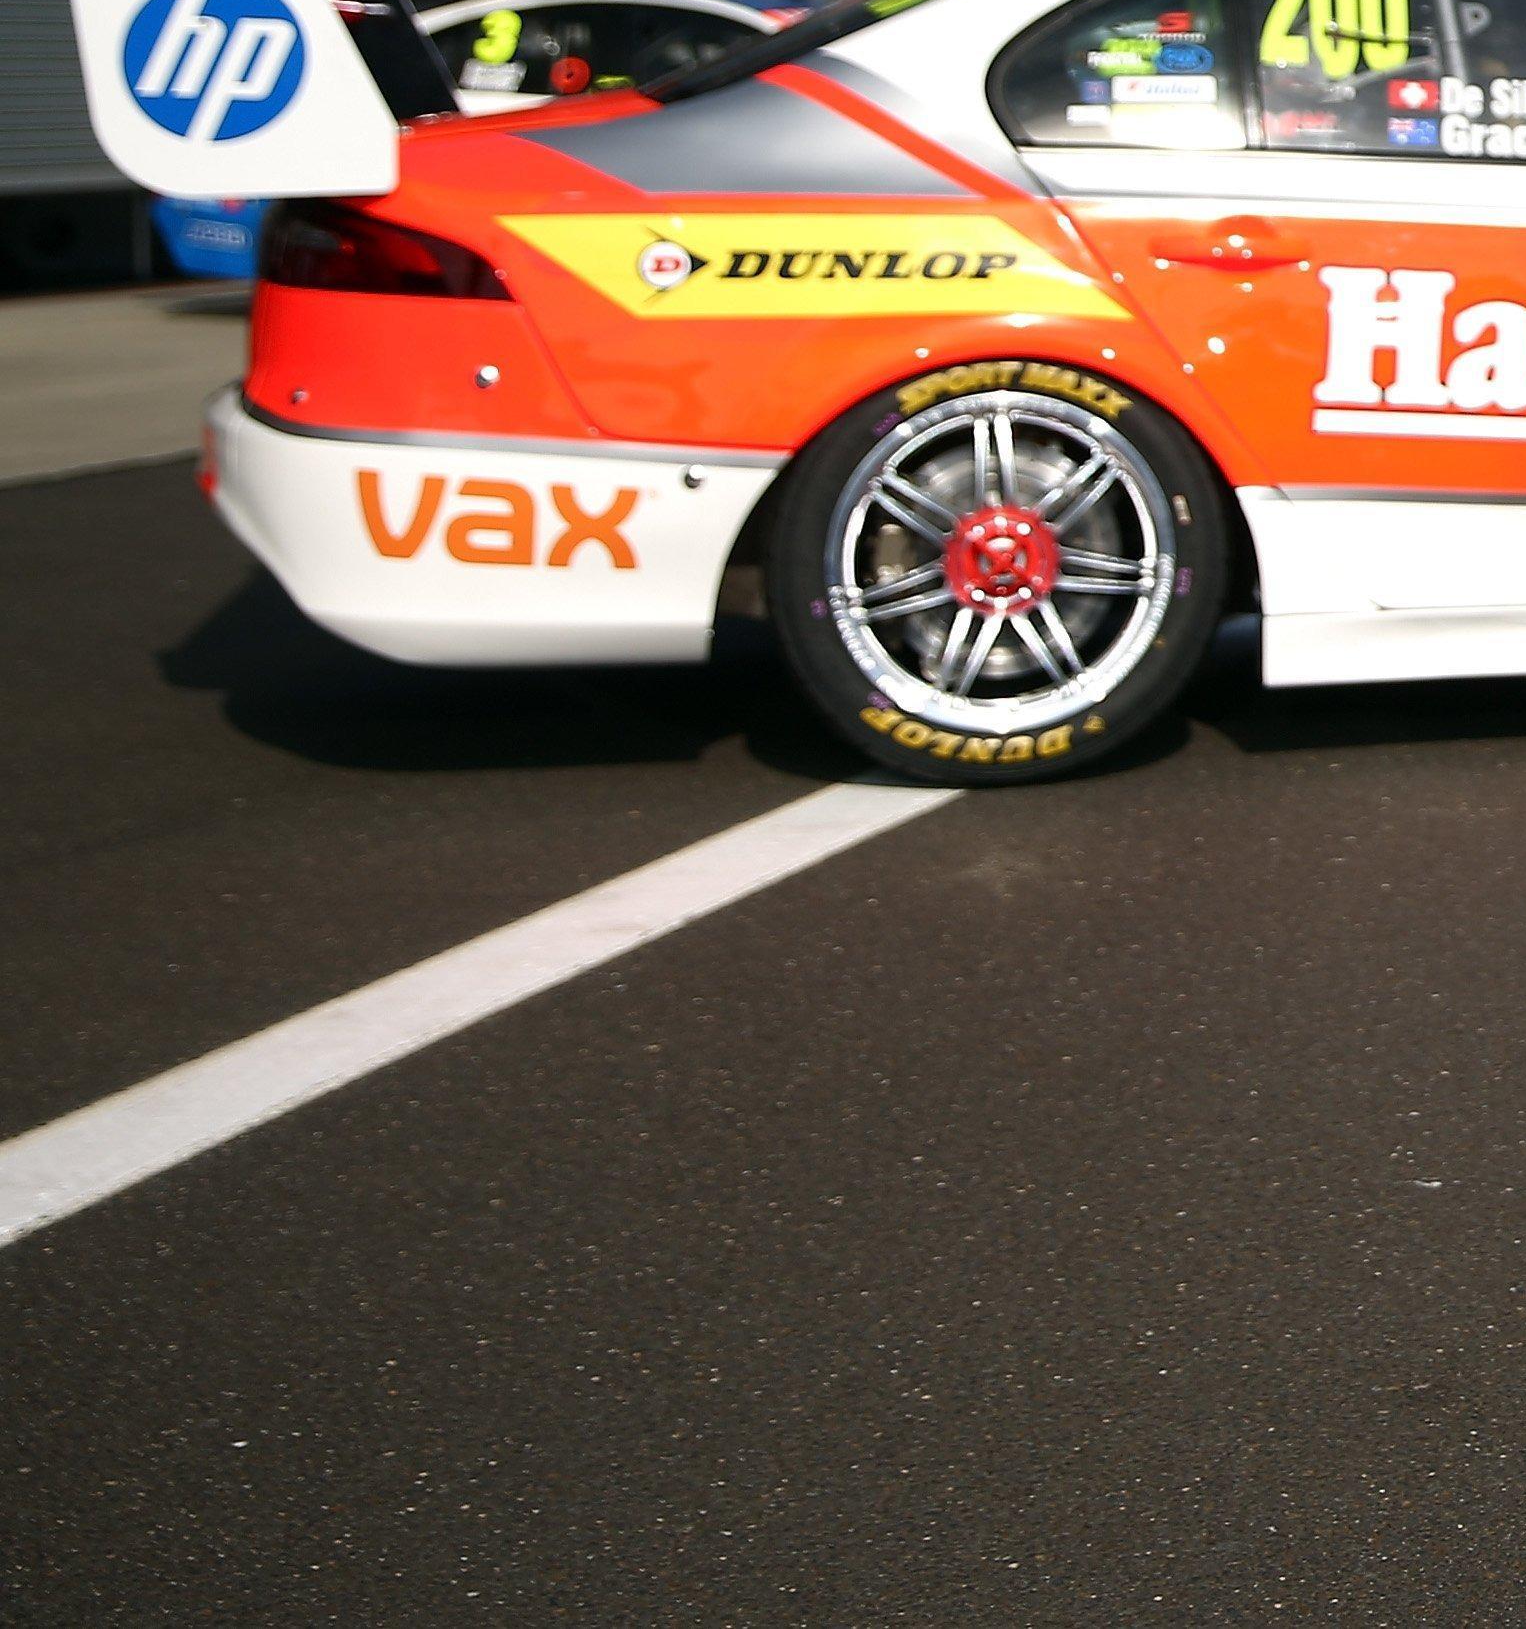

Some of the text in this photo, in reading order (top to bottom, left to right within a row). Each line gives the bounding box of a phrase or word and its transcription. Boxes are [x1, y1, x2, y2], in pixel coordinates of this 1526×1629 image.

[472, 9, 523, 64] 3
[1438, 75, 1485, 118] De
[719, 249, 1018, 281] DUNLOP
